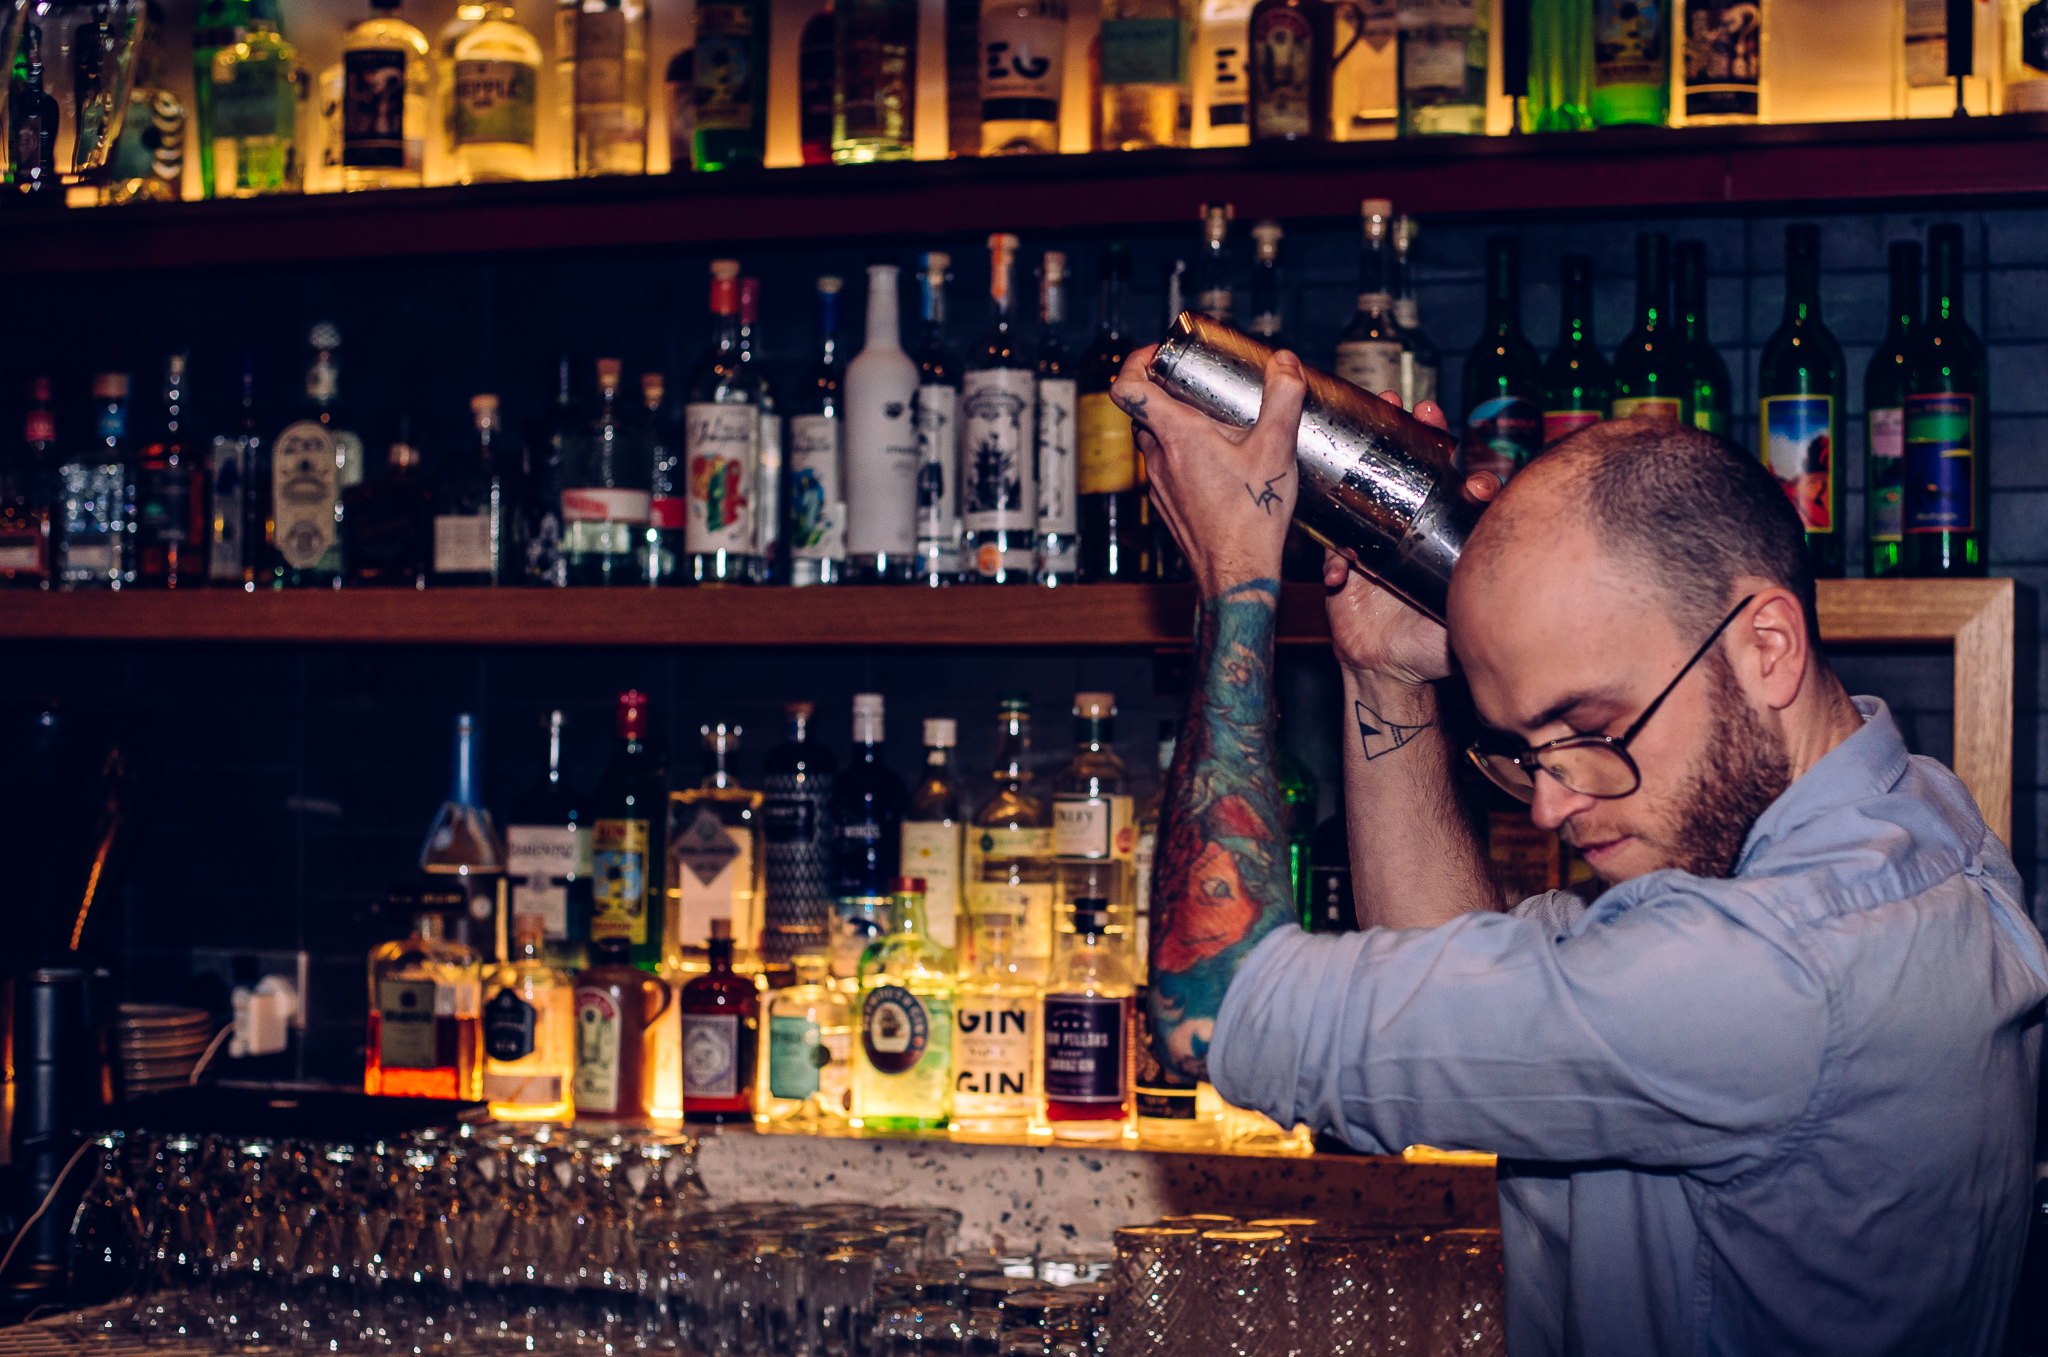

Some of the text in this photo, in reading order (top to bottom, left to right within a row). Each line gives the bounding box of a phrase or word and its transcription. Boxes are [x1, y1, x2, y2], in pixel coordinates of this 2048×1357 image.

[956, 1008, 1026, 1035] GIN
[1063, 1033, 1109, 1047] PILLARS
[955, 1069, 1025, 1096] GIN
